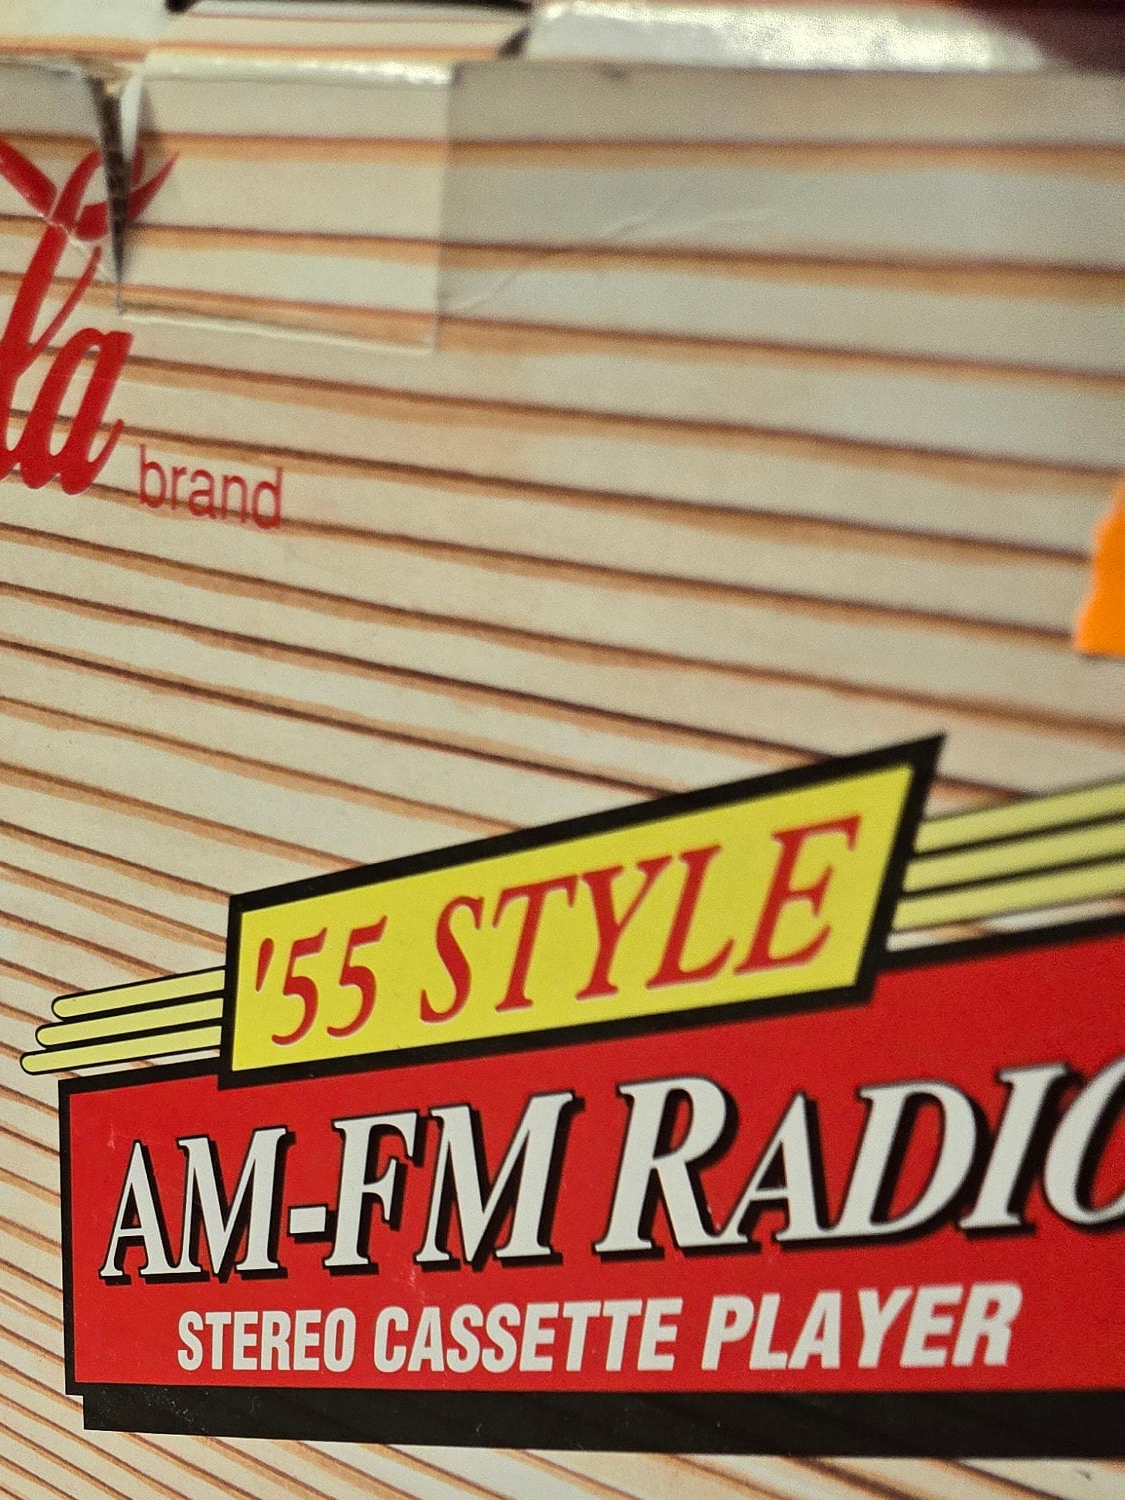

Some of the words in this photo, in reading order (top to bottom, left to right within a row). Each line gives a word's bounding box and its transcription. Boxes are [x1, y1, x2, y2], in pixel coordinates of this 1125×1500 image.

[137, 444, 284, 530] brand
[253, 913, 387, 1049] '55
[419, 813, 862, 1028] STYLE
[99, 1091, 581, 1283] AM-FM
[176, 1307, 357, 1373] STEREO
[374, 1298, 683, 1374] CASSETTE
[700, 1281, 1023, 1371] PLAYER
